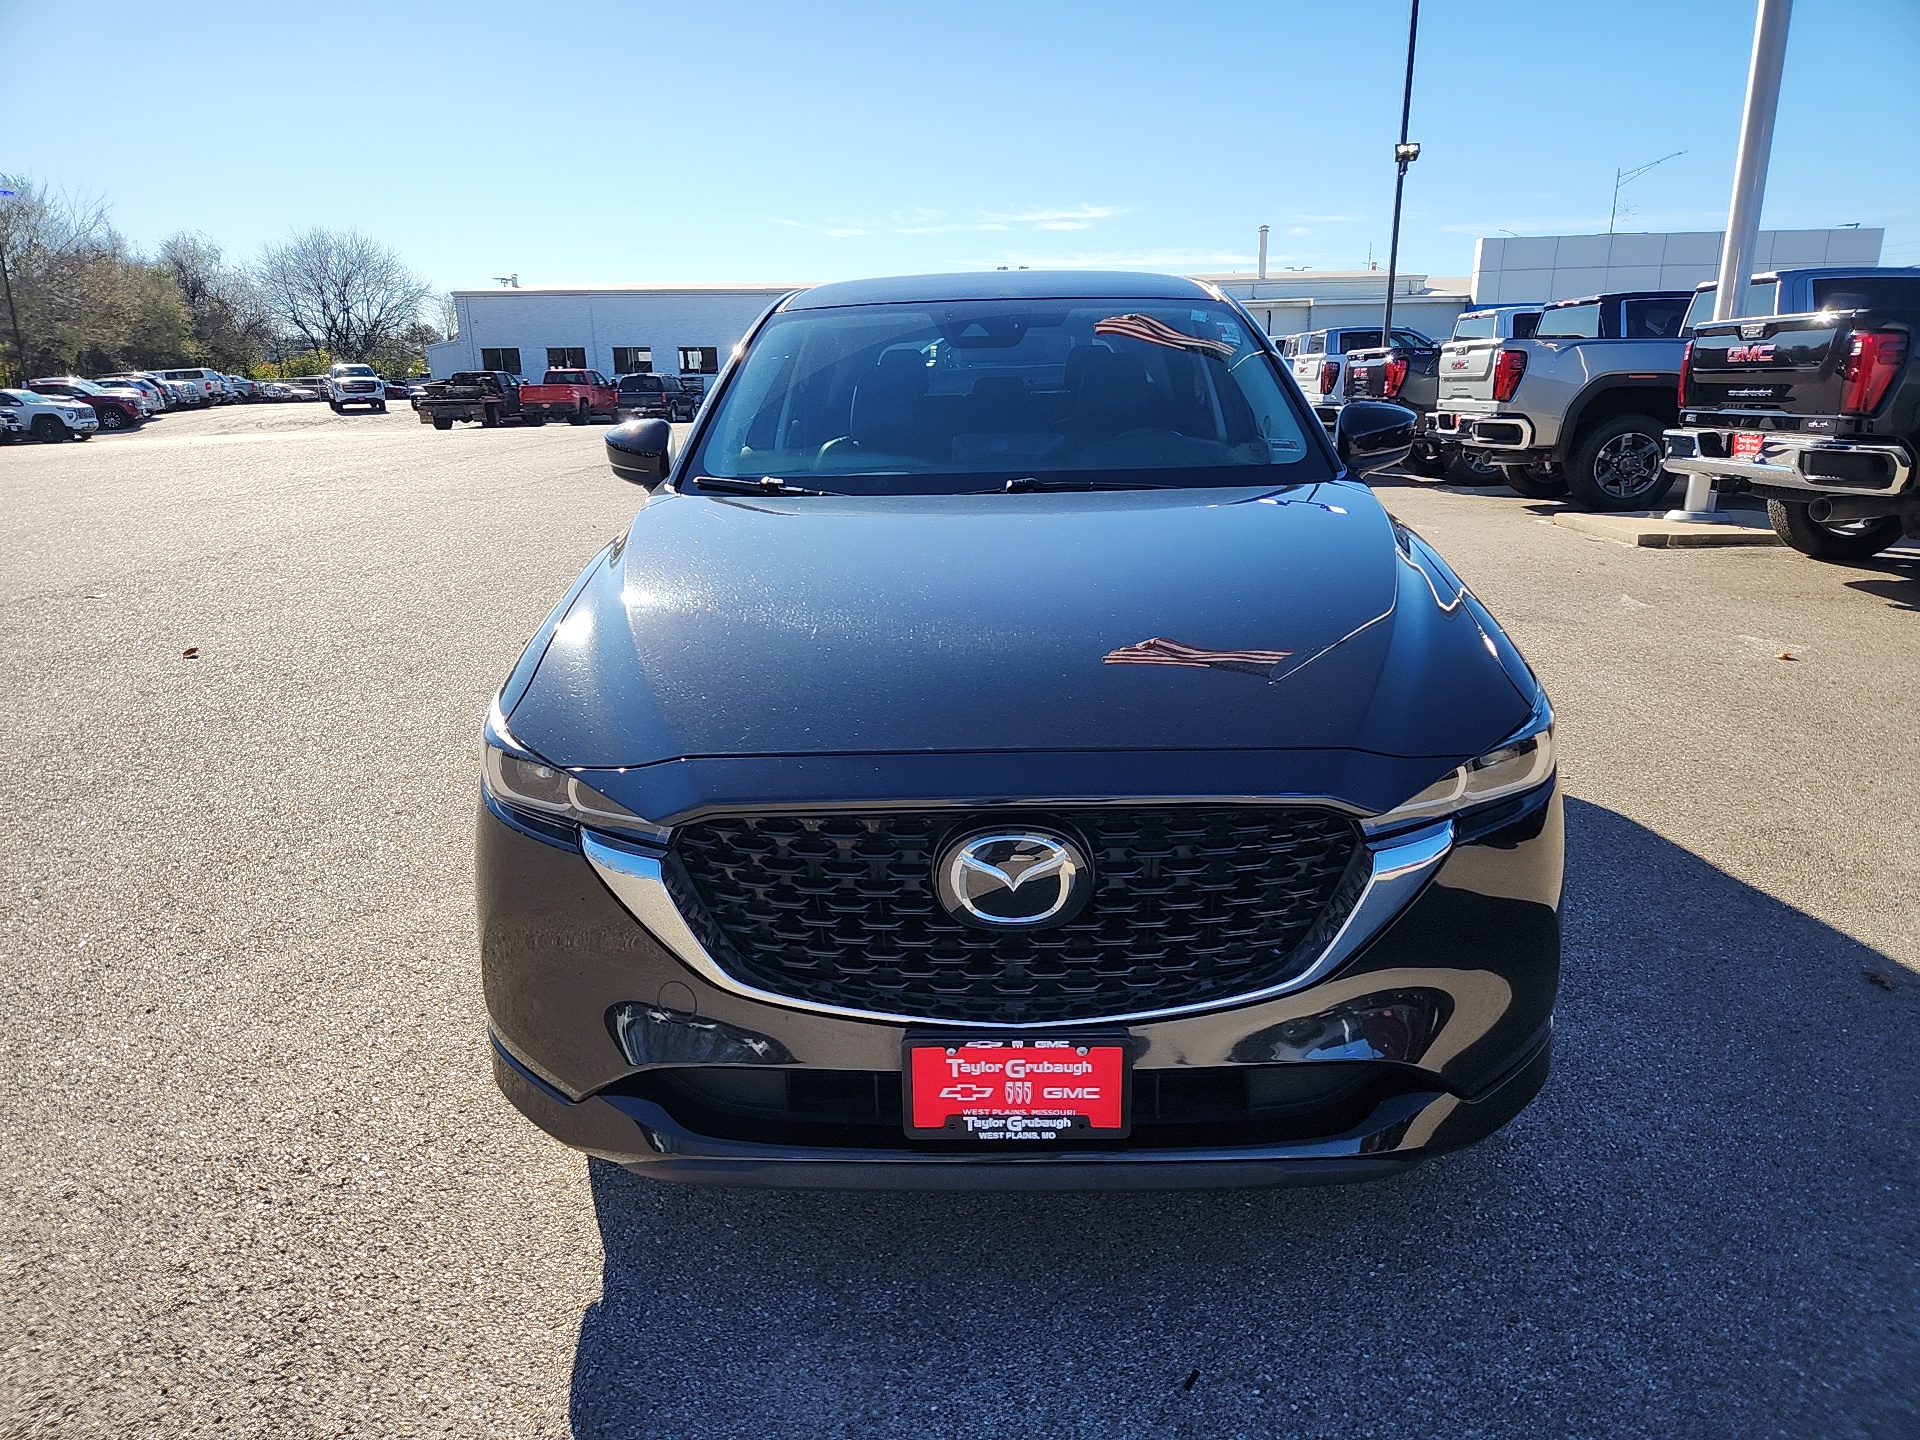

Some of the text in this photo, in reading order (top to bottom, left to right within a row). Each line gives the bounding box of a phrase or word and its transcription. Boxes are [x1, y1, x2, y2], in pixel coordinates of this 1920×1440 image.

[1727, 344, 1776, 362] GMC
[1034, 1040, 1070, 1049] GMC
[945, 1059, 1093, 1079] Taylor Grubaugh
[1043, 1087, 1101, 1099] GMC
[962, 1108, 990, 1116] WEST
[1031, 1109, 1077, 1117] MISSOURI
[963, 1116, 1072, 1132] Taylor Grubaugh
[978, 1131, 1004, 1140] WEST
[1041, 1131, 1057, 1140] MO
